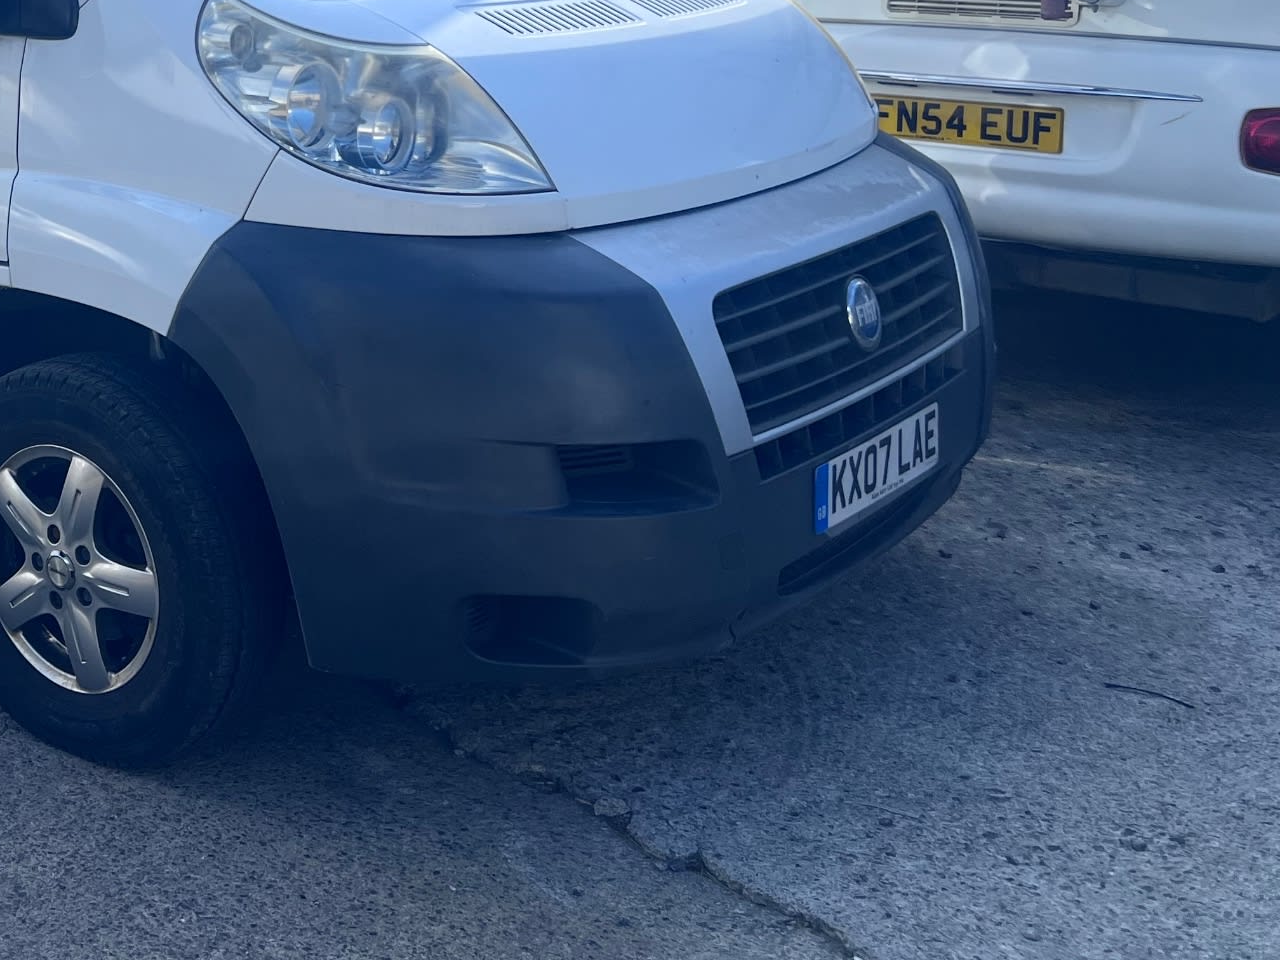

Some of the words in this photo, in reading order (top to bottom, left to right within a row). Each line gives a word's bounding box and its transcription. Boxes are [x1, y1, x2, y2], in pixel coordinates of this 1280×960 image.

[874, 98, 967, 137] FN54
[980, 107, 1057, 145] EUF
[832, 434, 892, 515] KX07
[898, 408, 936, 476] LAE
